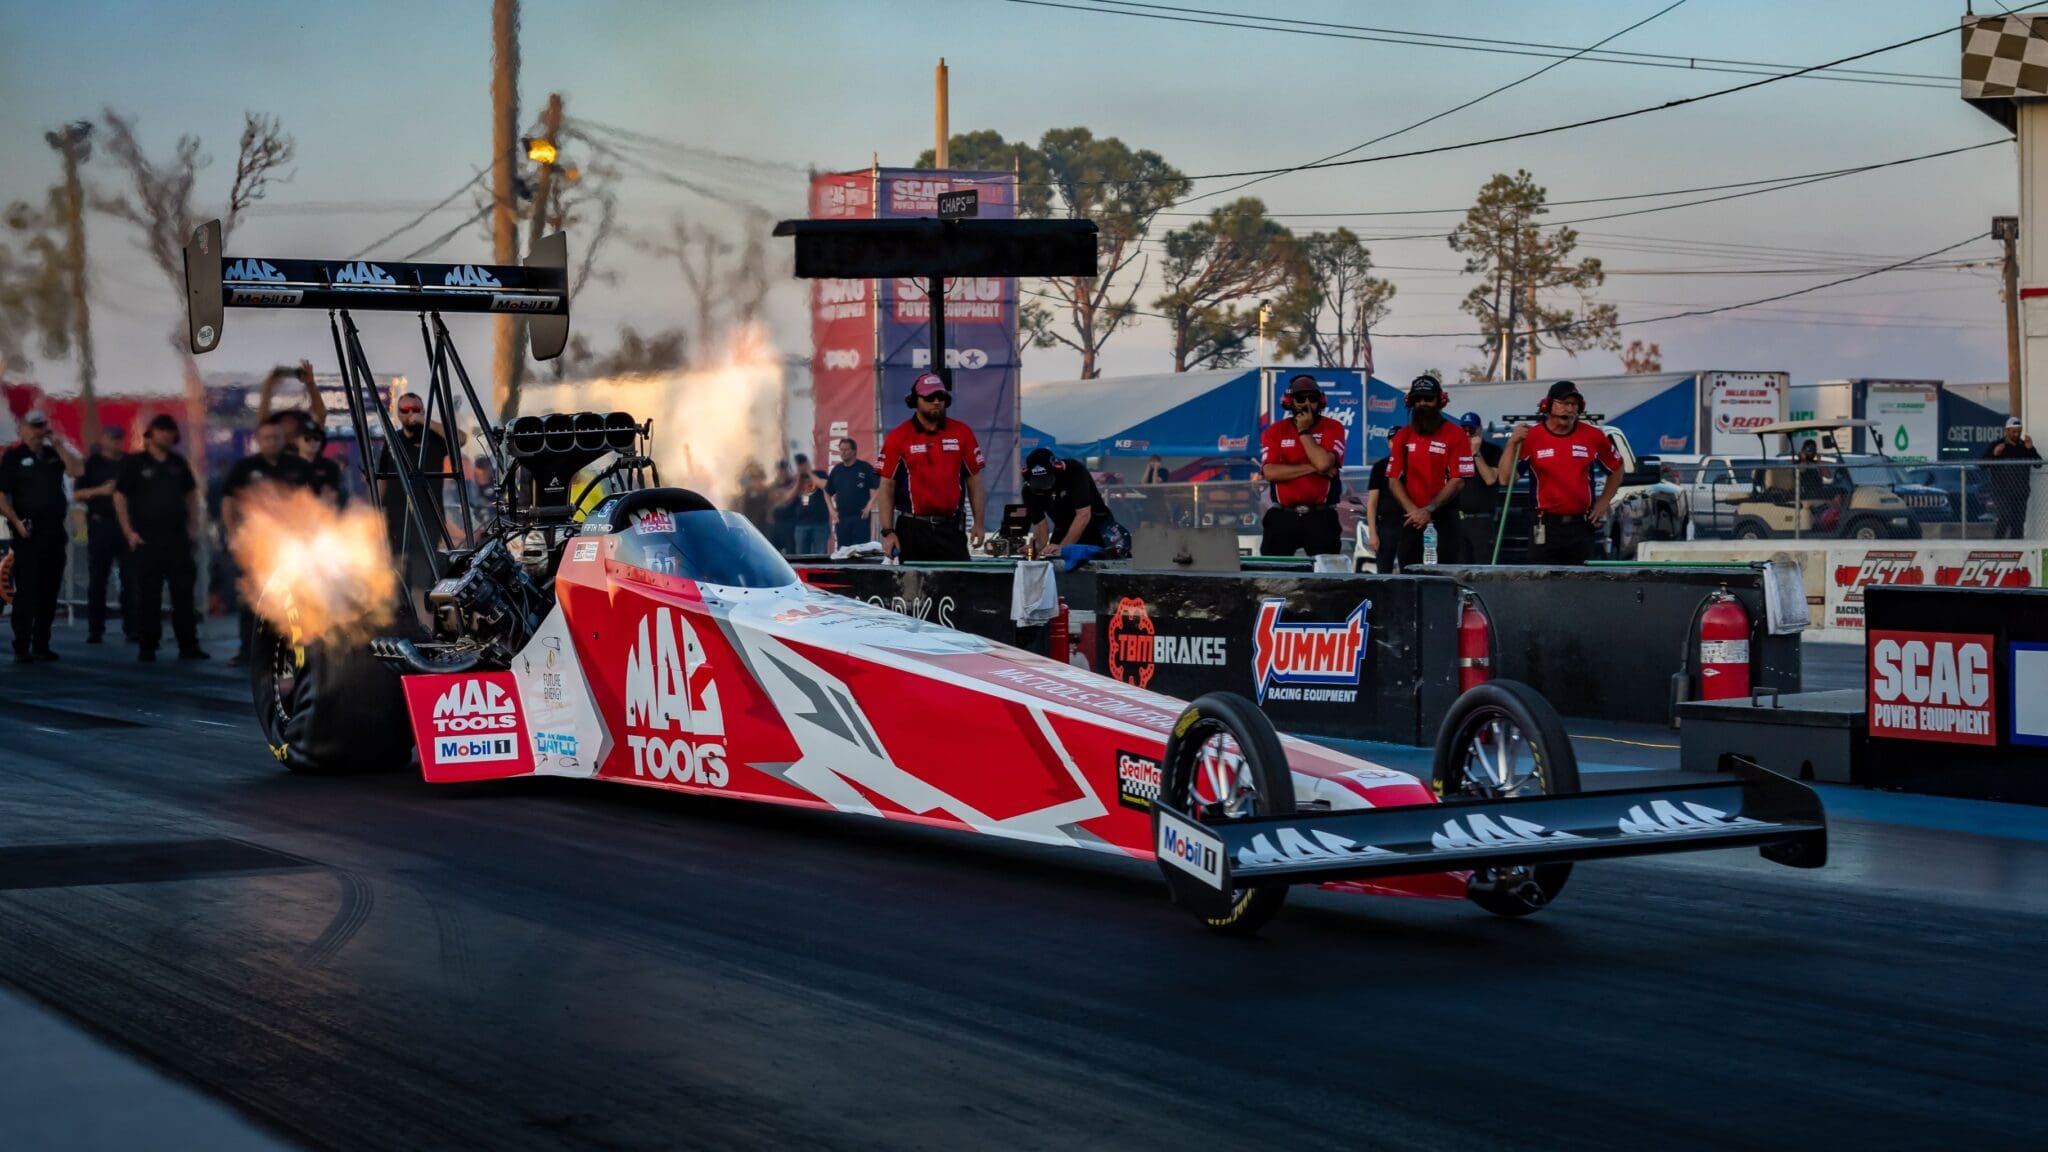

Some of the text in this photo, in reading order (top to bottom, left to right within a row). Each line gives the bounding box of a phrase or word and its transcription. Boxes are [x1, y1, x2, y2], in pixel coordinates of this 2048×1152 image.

[941, 197, 967, 213] CHAPS
[225, 258, 287, 282] MAC
[336, 261, 396, 285] MAC
[445, 264, 502, 288] MAC
[236, 294, 280, 304] Mobil
[897, 277, 1001, 301] SAG
[498, 300, 536, 310] Mobil
[898, 303, 930, 318] POWE
[1975, 426, 2004, 442] BIOF
[1848, 559, 1912, 594] PST
[1955, 560, 2015, 586] PST
[1836, 606, 1865, 615] RACING
[543, 673, 561, 687] FUTURE
[626, 606, 725, 737] MAC
[1874, 639, 1989, 707] SCAG
[433, 679, 516, 718] MAC
[544, 687, 562, 701] ENERGY
[1268, 688, 1358, 702] RACING EQUIPMENT
[433, 715, 517, 732] TOOLS
[1874, 703, 1990, 735] POWER EQUIPMENT
[441, 740, 491, 757] Mobil
[627, 734, 729, 788] TOOLS
[1120, 755, 1162, 785] SealMa
[1164, 825, 1202, 867] Mobil
